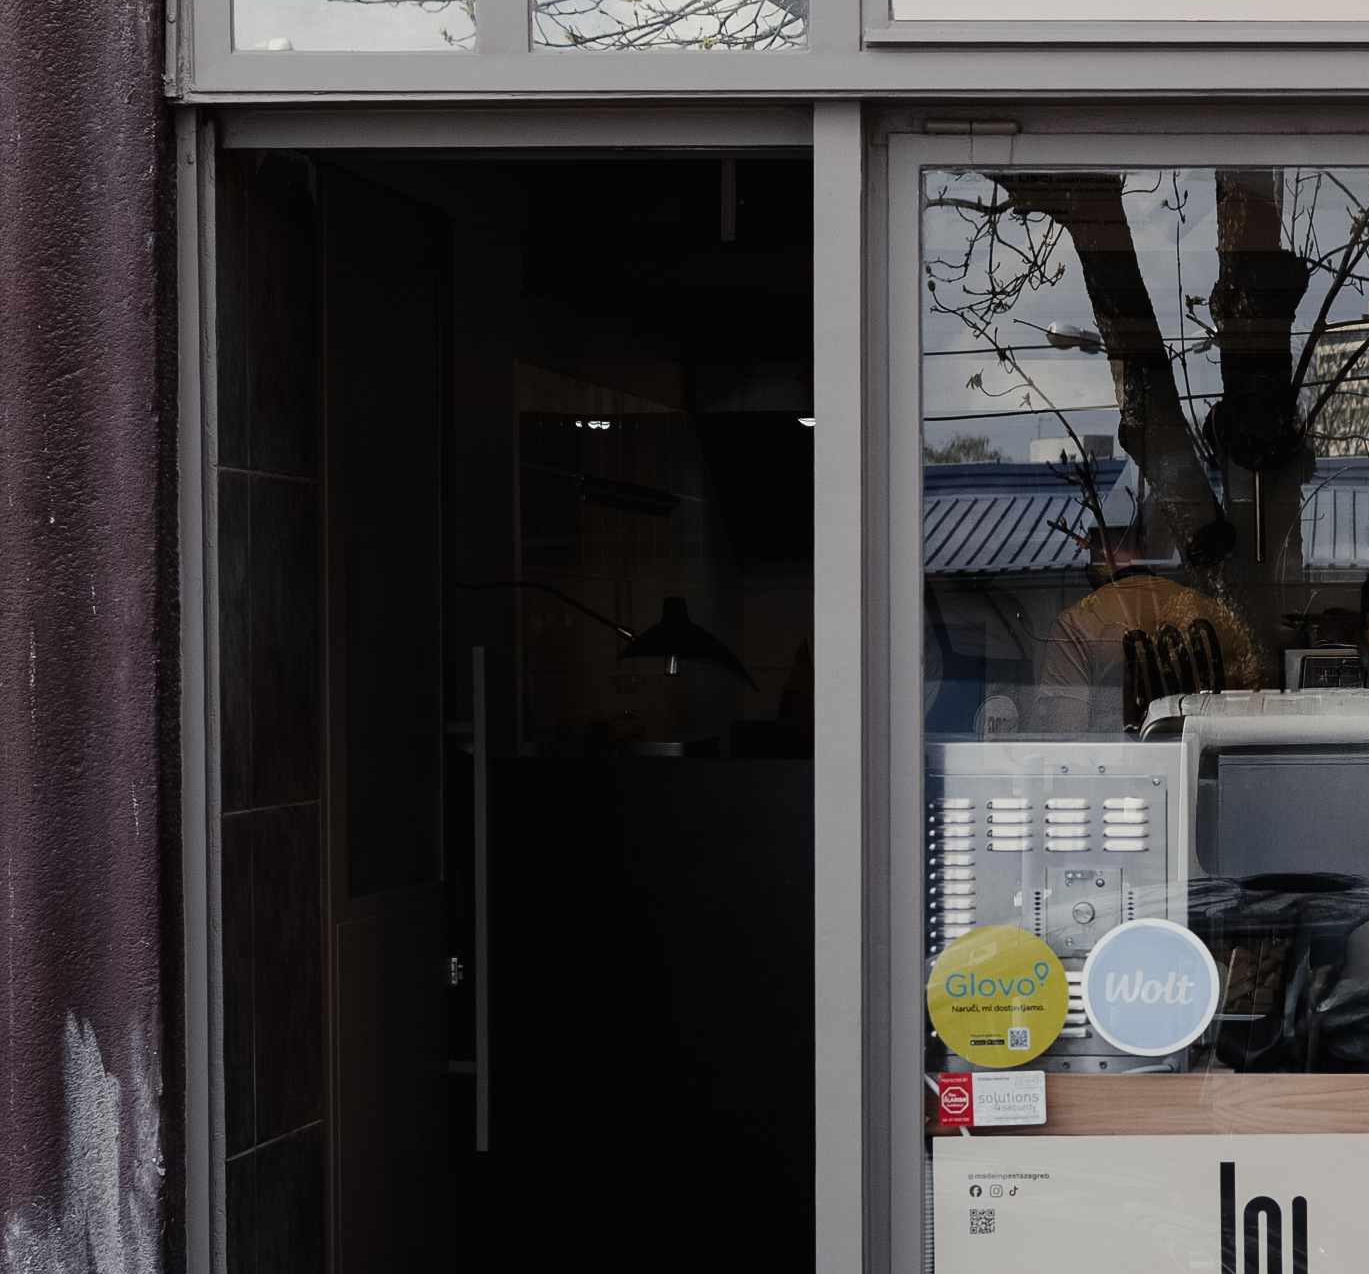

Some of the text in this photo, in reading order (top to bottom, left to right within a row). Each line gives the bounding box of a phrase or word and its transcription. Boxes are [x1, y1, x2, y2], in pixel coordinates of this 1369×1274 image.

[1018, 175, 1053, 184] LISCI
[1019, 186, 1050, 194] romano,
[945, 973, 1036, 998] Glovo
[1104, 970, 1195, 1005] Wolt
[952, 1004, 1045, 1013] Naruči, mi dostavljamo.
[978, 1091, 1040, 1104] solutions
[993, 1101, 1038, 1112] 4 security
[967, 1172, 1050, 1181] @madeinpastazagreb
